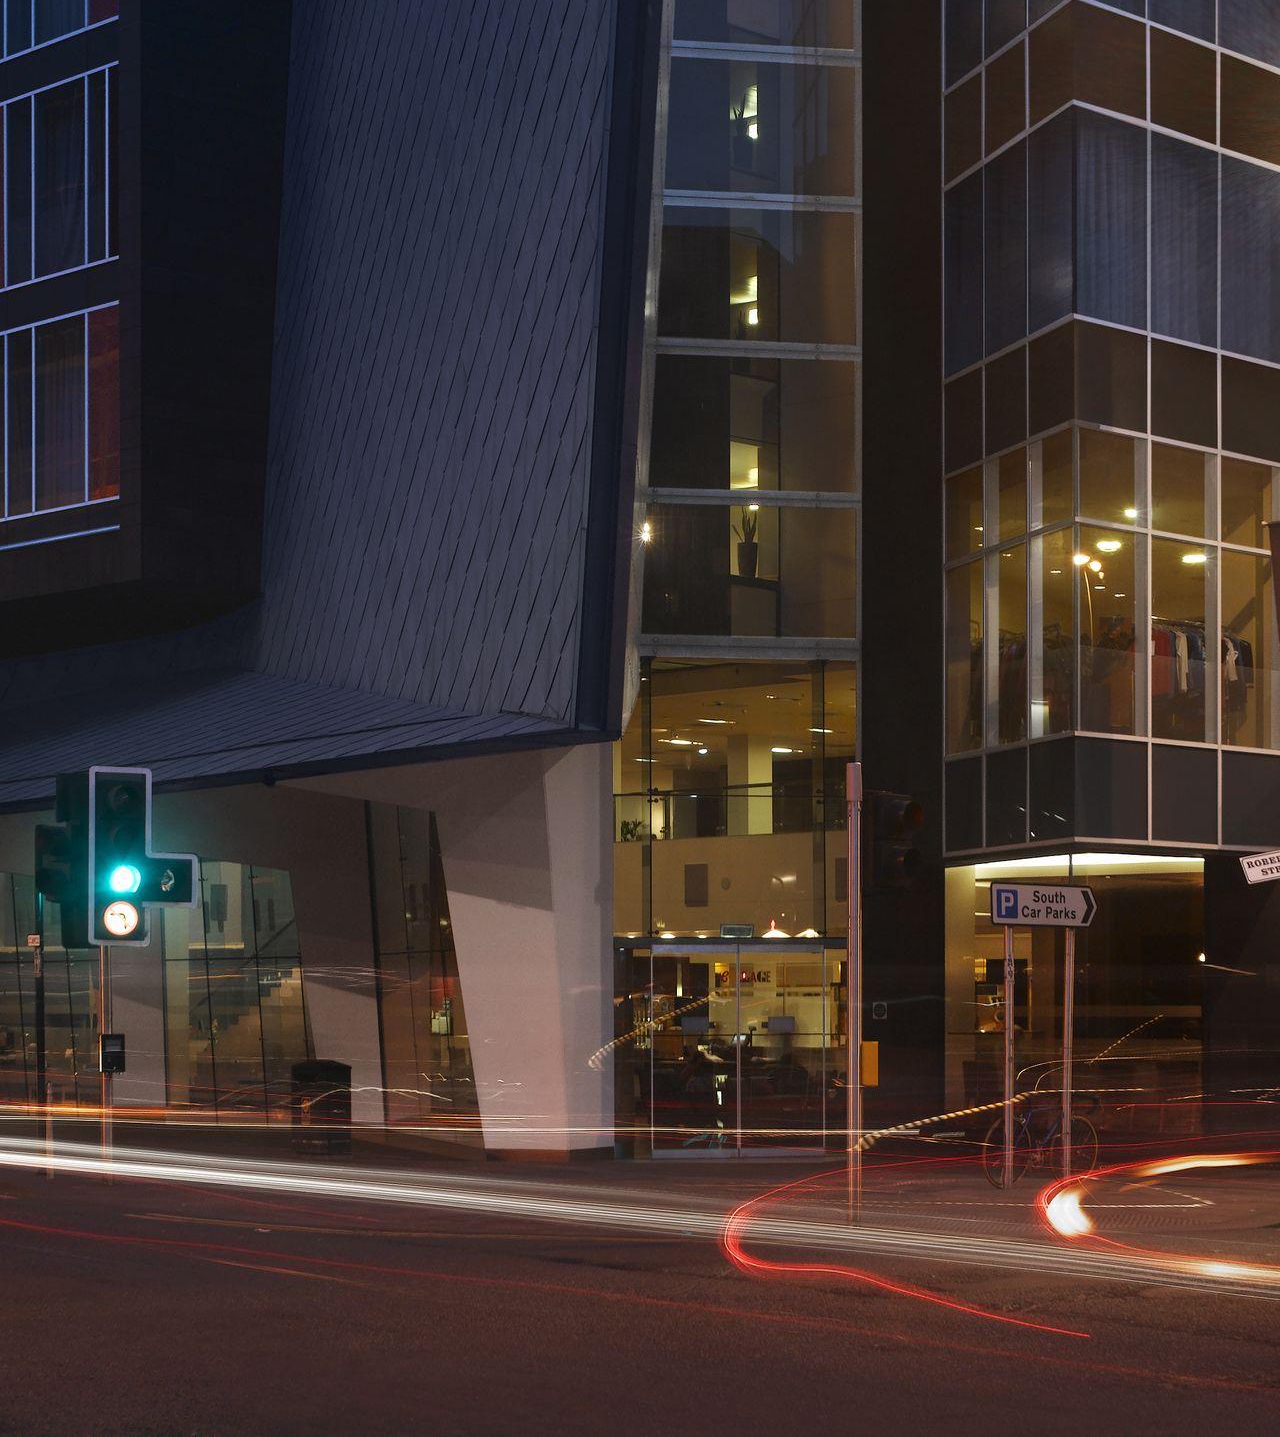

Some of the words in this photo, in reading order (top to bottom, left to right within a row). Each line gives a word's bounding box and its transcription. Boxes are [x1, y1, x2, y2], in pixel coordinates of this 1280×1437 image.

[1032, 890, 1066, 904] South
[1021, 905, 1041, 918] Car
[1045, 906, 1077, 920] Parks
